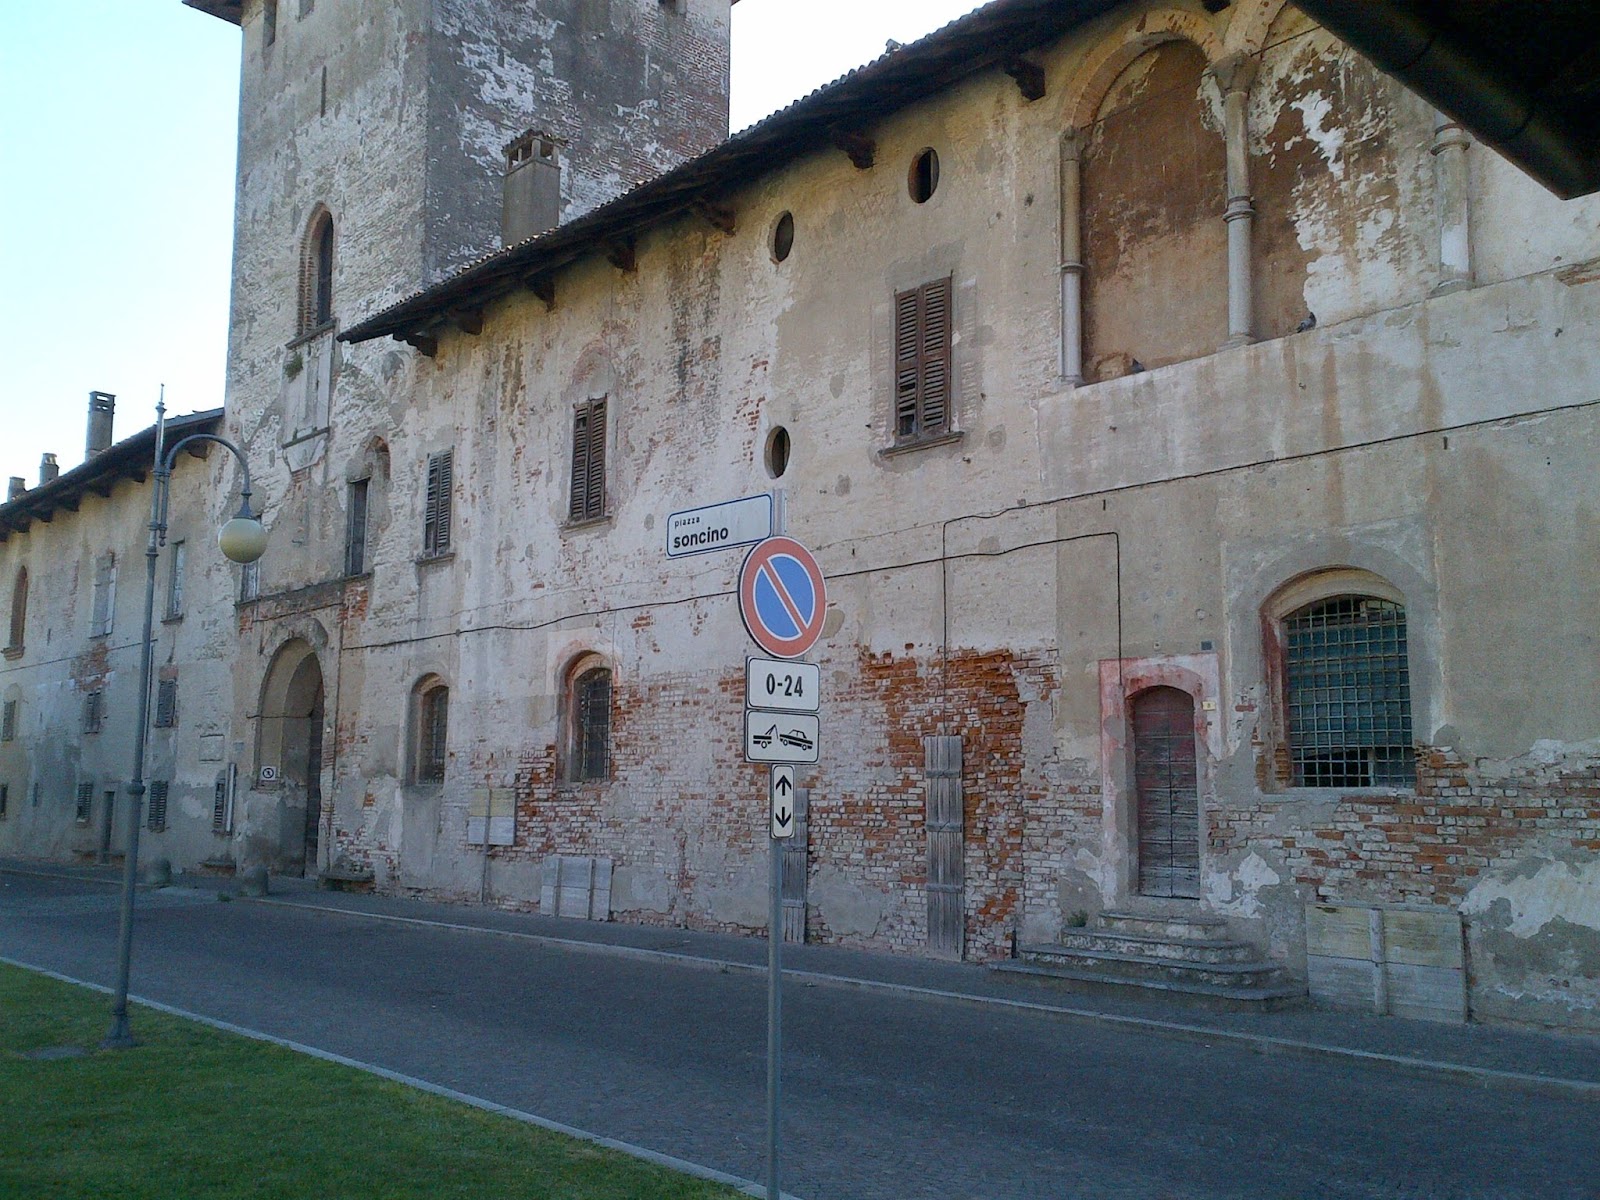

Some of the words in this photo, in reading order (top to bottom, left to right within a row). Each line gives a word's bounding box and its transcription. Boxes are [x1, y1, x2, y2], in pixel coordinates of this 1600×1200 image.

[674, 516, 700, 529] piazza
[673, 527, 729, 549] soncino
[766, 673, 803, 697] 0-24
